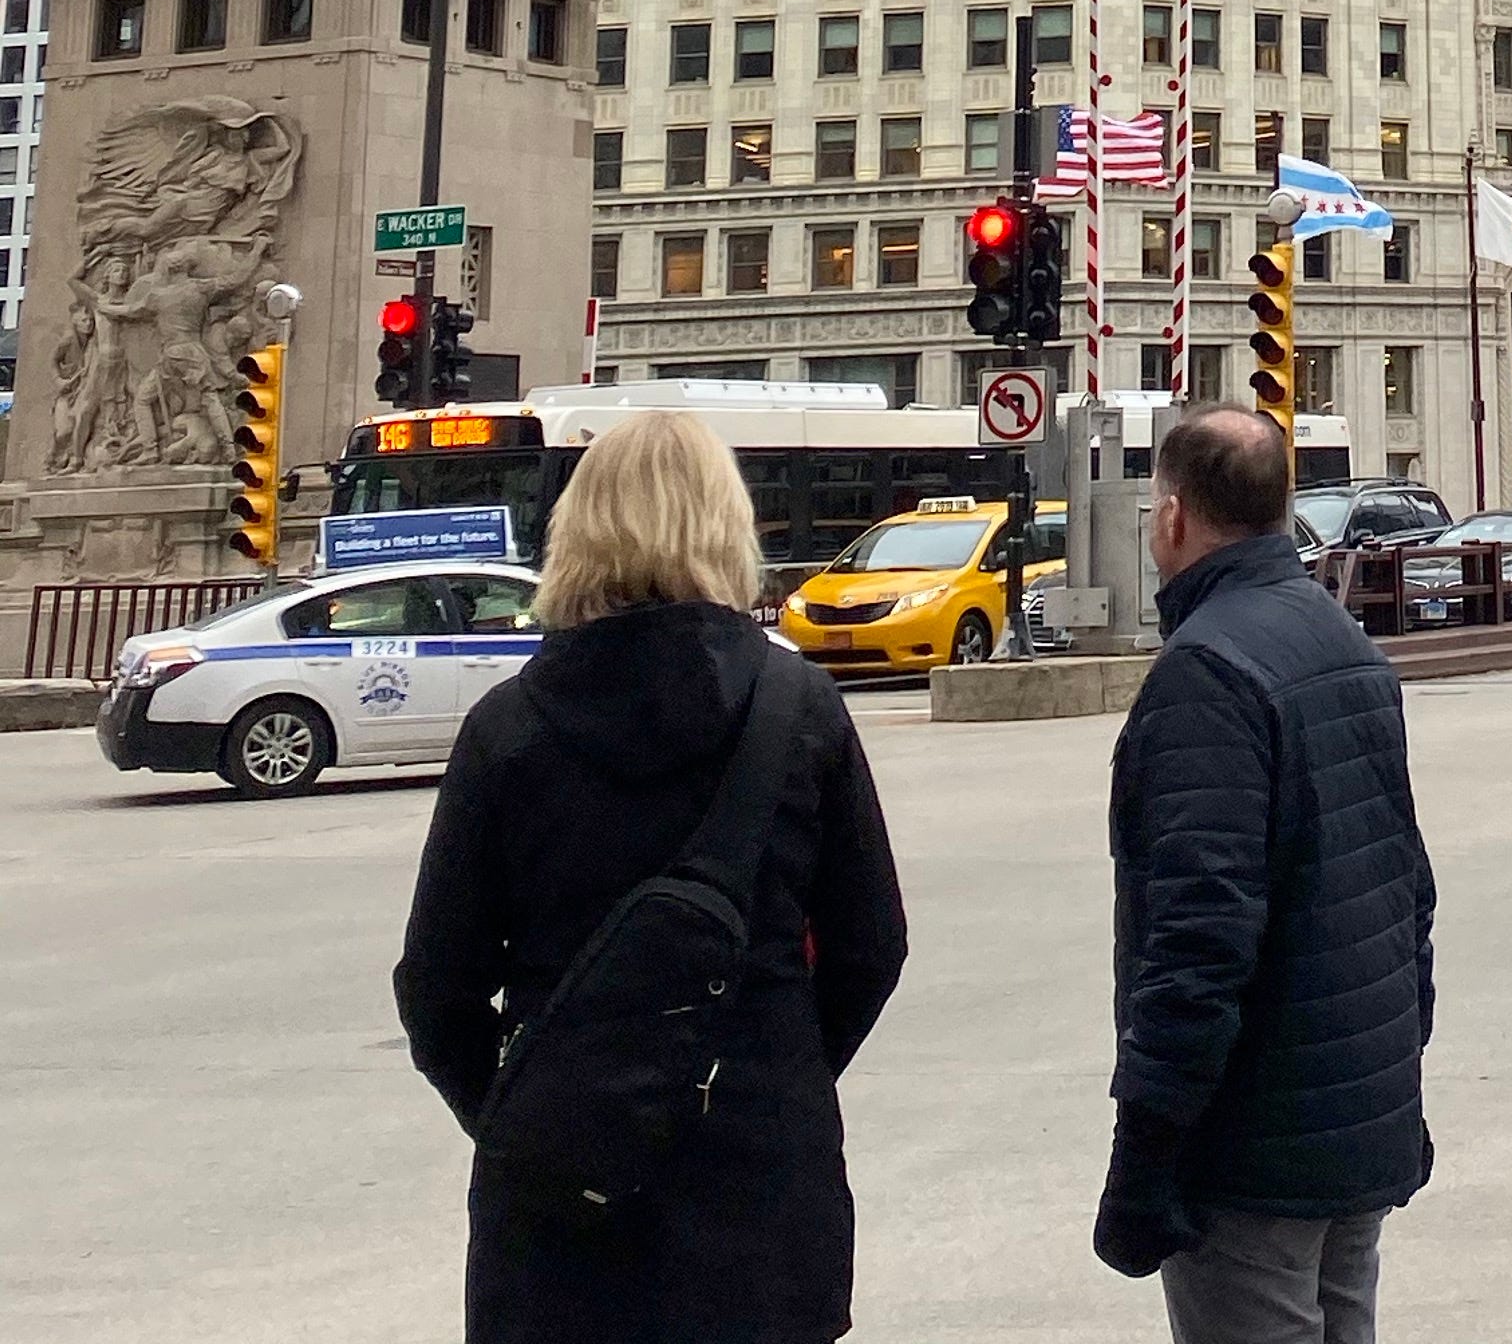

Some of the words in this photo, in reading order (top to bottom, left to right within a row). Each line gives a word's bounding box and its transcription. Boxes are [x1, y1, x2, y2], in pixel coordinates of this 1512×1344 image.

[377, 219, 385, 231] E
[388, 213, 445, 232] WACKER
[448, 213, 463, 227] DR
[402, 233, 423, 246] 340
[427, 231, 437, 245] N
[377, 422, 412, 453] 146
[382, 538, 391, 549] a
[420, 534, 439, 546] for
[440, 532, 460, 545] the
[361, 640, 408, 656] 3224
